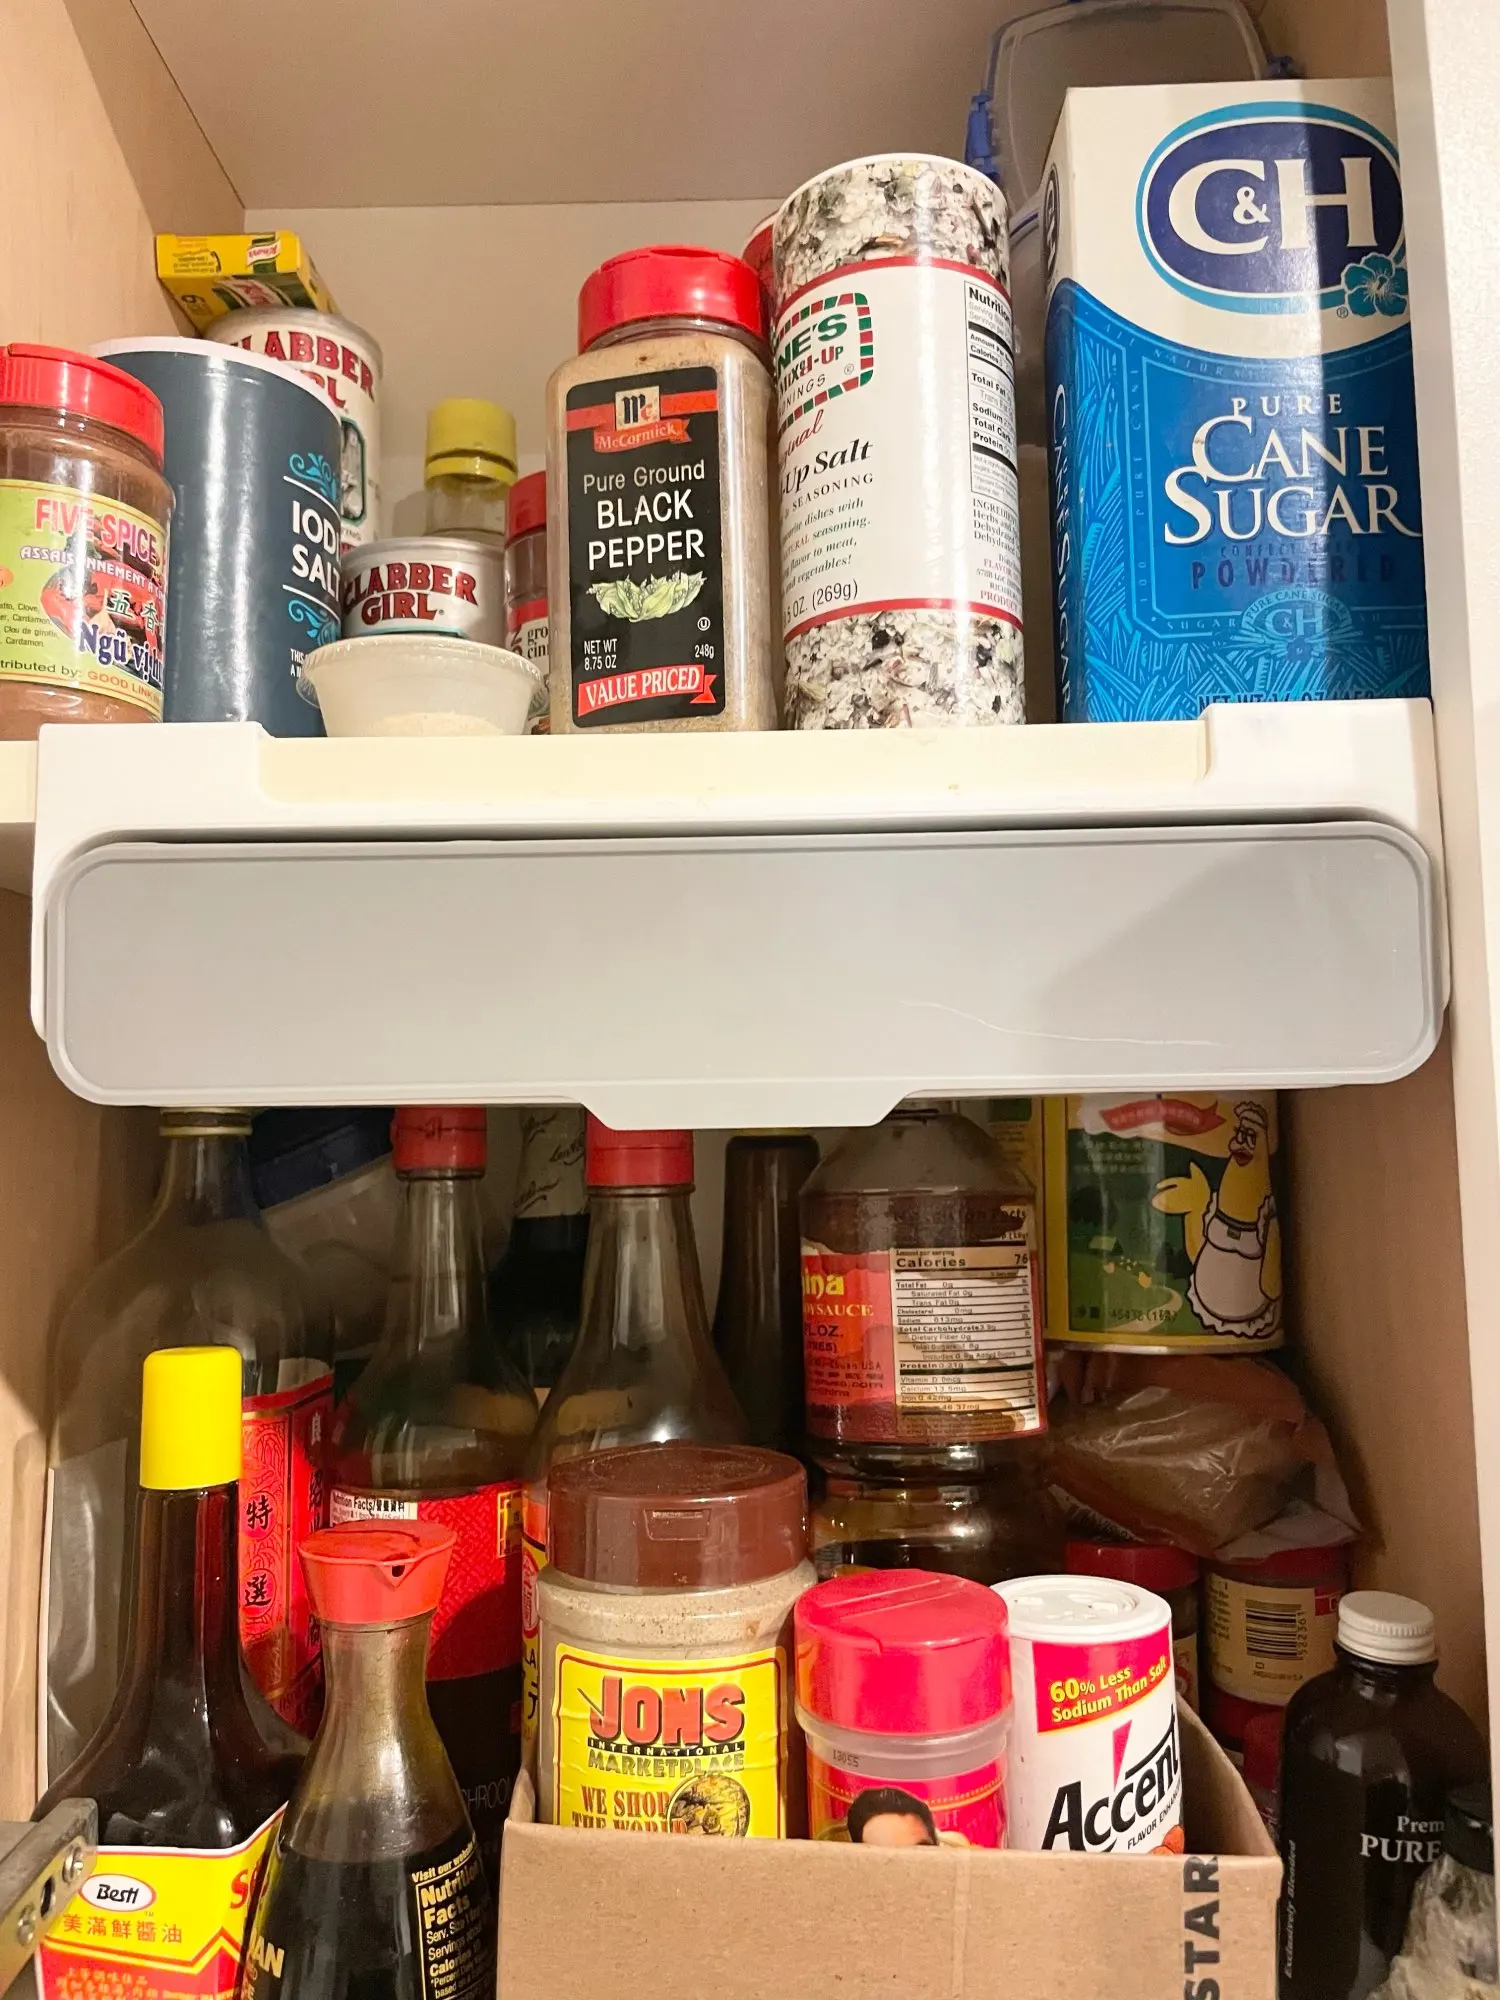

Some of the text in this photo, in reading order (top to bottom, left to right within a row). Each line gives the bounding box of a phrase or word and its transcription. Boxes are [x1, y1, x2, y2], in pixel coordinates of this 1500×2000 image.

[1168, 156, 1379, 256] C&H
[1231, 393, 1343, 418] PURE
[814, 438, 874, 475] Salt
[1192, 415, 1389, 483] CANE
[584, 459, 706, 495] Pure Ground
[792, 472, 874, 513] SEASONING
[597, 488, 694, 531] BLACK
[838, 496, 864, 516] with
[1164, 463, 1424, 546] SUGAR
[35, 499, 158, 565] FIVE SPICE
[588, 528, 706, 572] PEPPER
[20, 546, 147, 587] ASSAISNNEMENT
[292, 543, 340, 602] SALT
[343, 562, 478, 617] CLABBER
[812, 577, 860, 613] (269g)
[361, 591, 438, 626] GIRL
[584, 638, 618, 655] NET WT
[584, 654, 618, 671] 8.75 OZ
[694, 643, 715, 660] 248g
[87, 670, 129, 689] GOOD
[586, 665, 701, 708] VALUE PRICED
[896, 1256, 967, 1269] Calories
[900, 1361, 938, 1369] Protein
[1050, 1666, 1131, 1703] 60% Less
[1052, 1655, 1167, 1723] Sodium Than Salt
[577, 1675, 746, 1746] JONS
[588, 1749, 745, 1778] MARKETPLACE
[589, 1738, 742, 1757] INTERNATIONAL
[1041, 1703, 1179, 1853] Accent
[581, 1784, 608, 1815] WE
[1127, 1822, 1158, 1850] FLAVOR
[1396, 1815, 1445, 1833] Prem
[1359, 1832, 1442, 1863] PURE
[423, 1894, 471, 1930] Facts
[1183, 1855, 1221, 2000] STAR
[426, 1928, 449, 1945] Serv.
